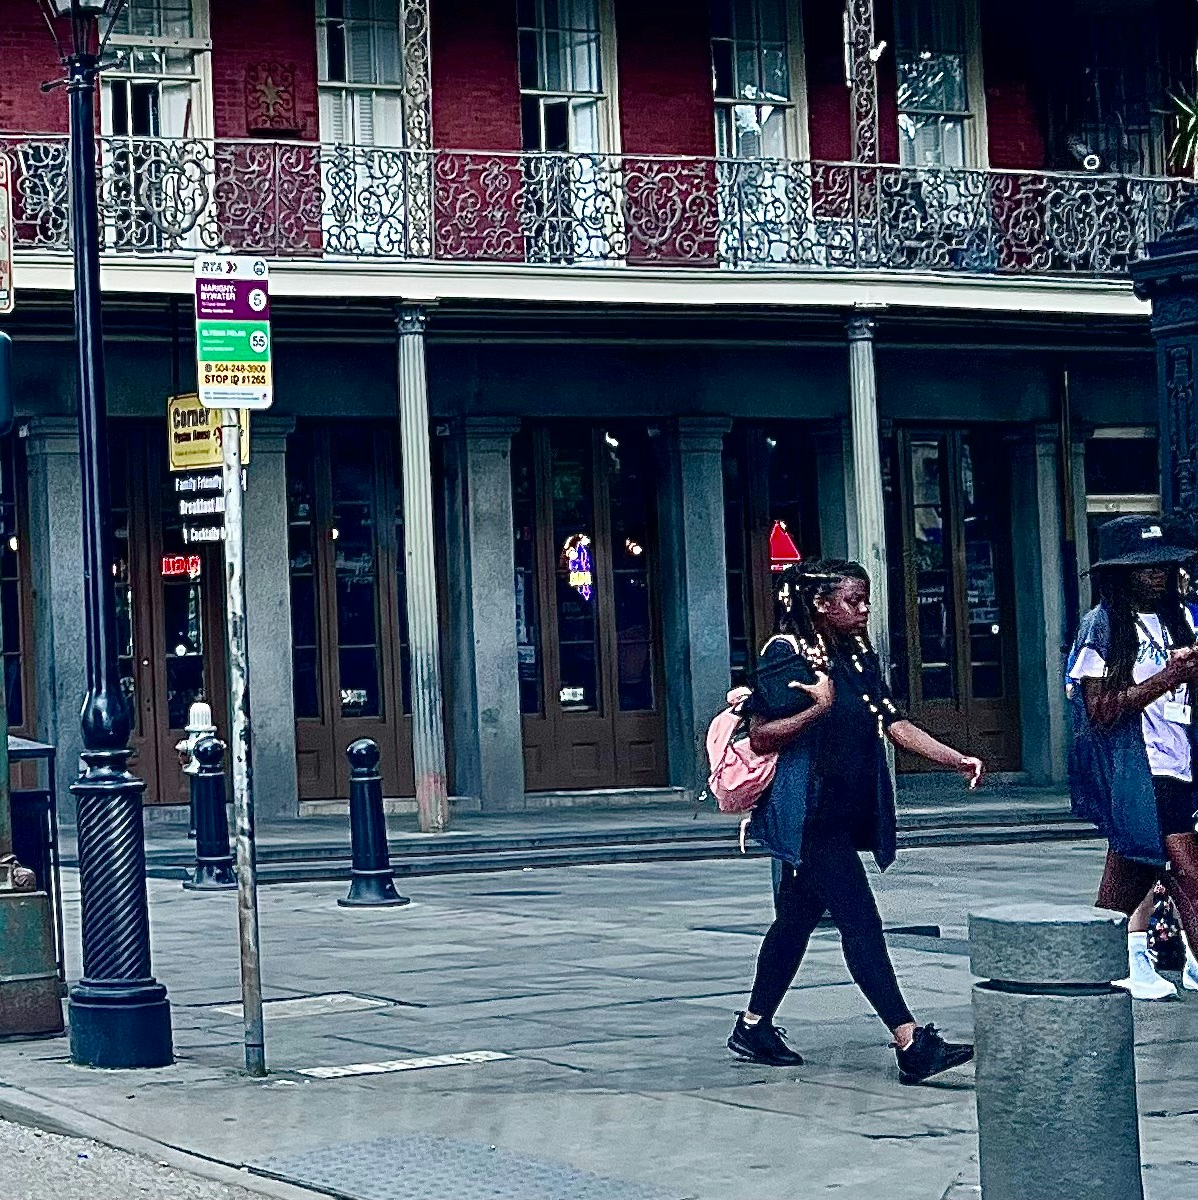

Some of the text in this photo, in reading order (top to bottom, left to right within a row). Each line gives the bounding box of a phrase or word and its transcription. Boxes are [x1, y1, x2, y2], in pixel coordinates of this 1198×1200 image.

[202, 262, 222, 272] RTA
[253, 293, 262, 306] 5
[252, 335, 266, 348] 55
[205, 375, 228, 384] STOP
[173, 407, 210, 429] Corner
